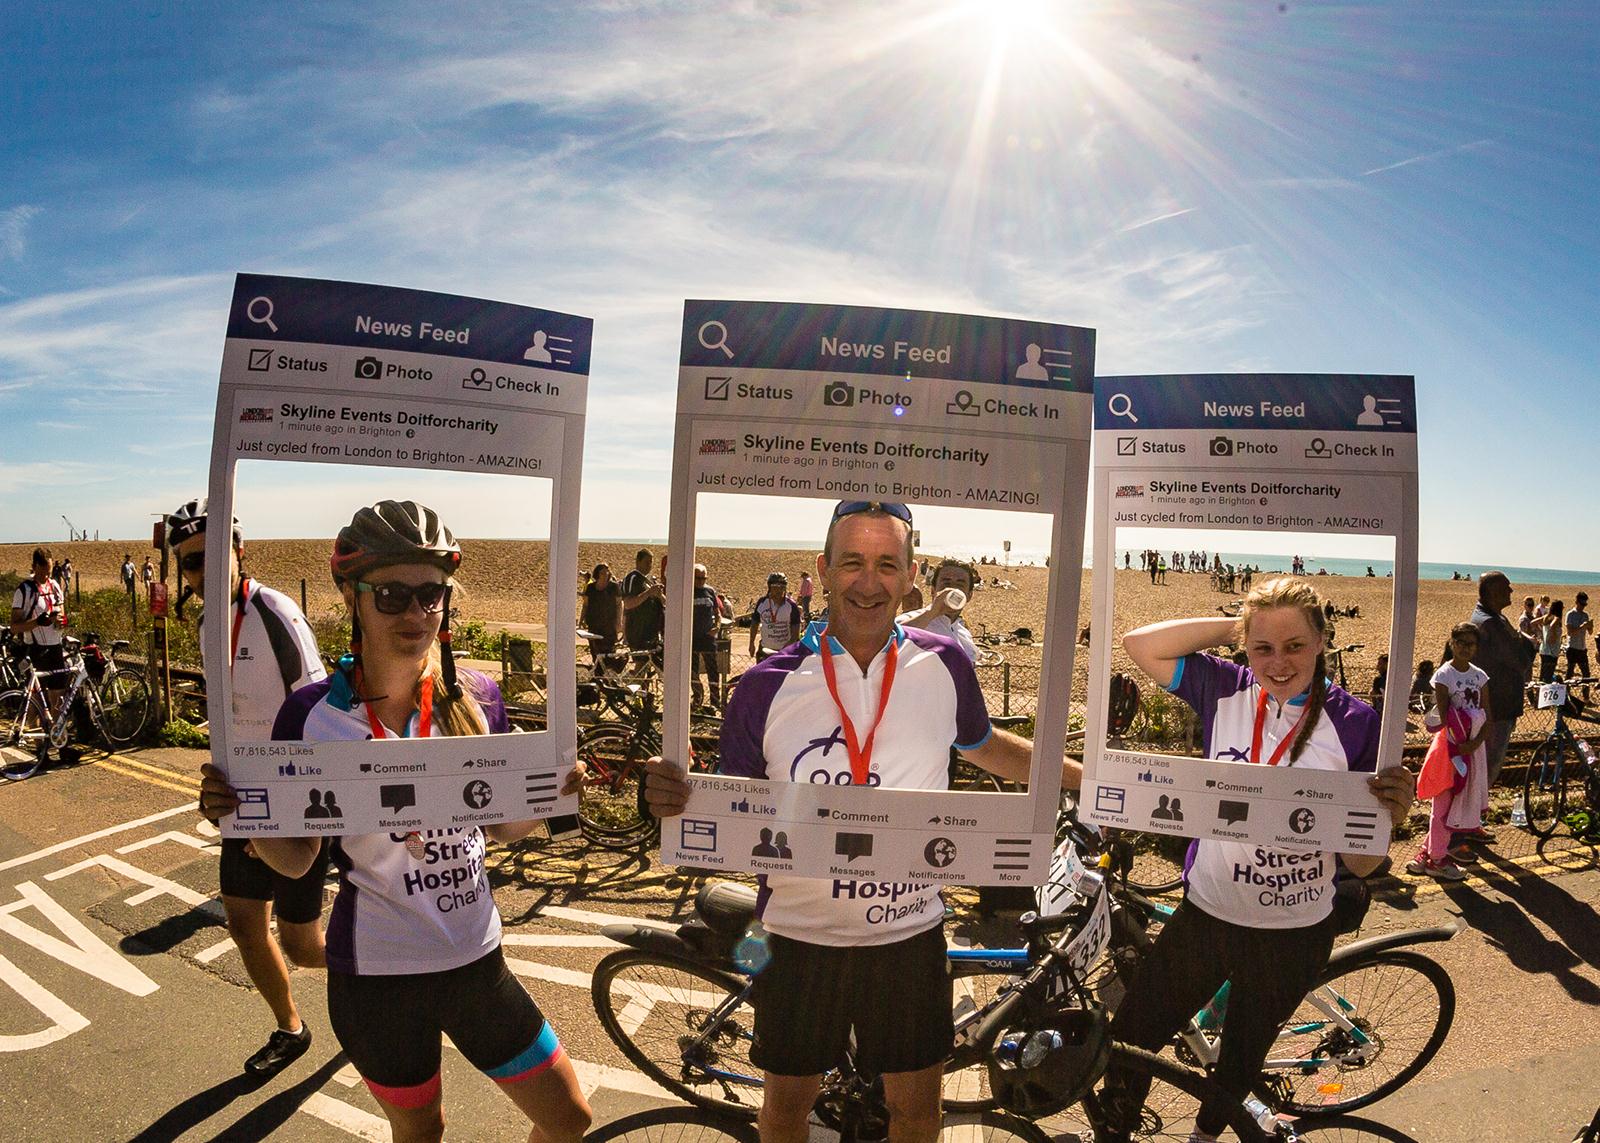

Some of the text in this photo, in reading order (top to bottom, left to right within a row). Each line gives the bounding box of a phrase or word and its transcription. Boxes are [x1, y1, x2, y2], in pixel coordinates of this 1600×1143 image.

[355, 315, 470, 345] News Feed
[821, 336, 952, 365] News Feed
[277, 355, 328, 373] Status
[386, 364, 433, 381] Photo
[495, 376, 560, 396] Check In
[736, 383, 793, 401] Status
[859, 388, 913, 407] Photo
[984, 398, 1059, 419] Check In
[1203, 402, 1305, 418] News Feed
[280, 403, 336, 423] Skyline
[340, 407, 392, 425] Events
[397, 411, 499, 435] Doitforcharity
[288, 422, 322, 433] minute
[324, 426, 344, 435] ago
[347, 425, 356, 434] in
[359, 425, 401, 440] Brighton
[743, 434, 806, 454] Skyline
[811, 437, 869, 456] Events
[874, 440, 989, 466] Doitforcharity
[1141, 441, 1186, 454] Status
[1236, 441, 1278, 454] Photo
[1334, 443, 1394, 457] Check In
[236, 439, 263, 453] Just
[266, 441, 307, 456] cycled
[311, 442, 340, 456] from
[345, 444, 392, 460] London
[396, 447, 408, 460] to
[413, 448, 465, 467] Brighton
[476, 454, 542, 470] AMAZING!
[753, 454, 791, 465] minute
[793, 457, 815, 469] ago
[818, 455, 828, 467] in
[832, 455, 880, 471] Brighton
[696, 472, 726, 486] Just
[730, 474, 776, 491] cycled
[779, 476, 812, 490] from
[817, 478, 870, 495] London
[874, 481, 888, 495] to
[893, 482, 952, 503] Brighton
[965, 488, 1040, 505] AMAZING!
[1149, 481, 1197, 496] Skyline
[1201, 482, 1247, 494] Events
[1251, 482, 1341, 499] Doitforcharity
[1157, 496, 1187, 504] minute
[1190, 498, 1206, 506] ago
[1219, 496, 1256, 507] Brighton
[1114, 511, 1137, 522] Just
[1140, 512, 1176, 525] cycled
[1179, 512, 1204, 523] from
[1208, 513, 1249, 524] London
[1252, 515, 1263, 525] to
[1267, 514, 1314, 529] Brighton
[1324, 517, 1384, 529] AMAZING!
[1543, 690, 1559, 701] 926
[234, 745, 314, 757] 97,816,543 Likes
[476, 757, 507, 769] Share
[1103, 753, 1170, 768] 97,816,543 Likes
[299, 765, 322, 776] Like
[373, 762, 427, 774] Comment
[1154, 775, 1174, 785] Like
[743, 784, 771, 795] Likes
[1217, 781, 1263, 794] Comment
[1306, 789, 1334, 800] Share
[533, 805, 553, 815] More
[752, 804, 777, 816] Like
[379, 818, 422, 828] Messages
[451, 811, 504, 824] Notifications
[832, 810, 889, 824] Comment
[944, 815, 978, 827] Share
[1090, 813, 1129, 825] News Feed
[233, 822, 279, 832] News Feed
[304, 821, 345, 832] Requests
[1149, 820, 1184, 832] Requests
[1212, 828, 1249, 839] Messages
[1274, 835, 1321, 846] Notifications
[1348, 841, 1367, 850] More
[675, 851, 724, 865] News Feed
[750, 859, 793, 871] Requests
[829, 866, 875, 877] Messages
[908, 870, 966, 881] Notifications
[999, 872, 1021, 881] More
[1233, 860, 1324, 892] Hospital
[832, 879, 934, 902] Hospi
[1258, 885, 1324, 907] Charity
